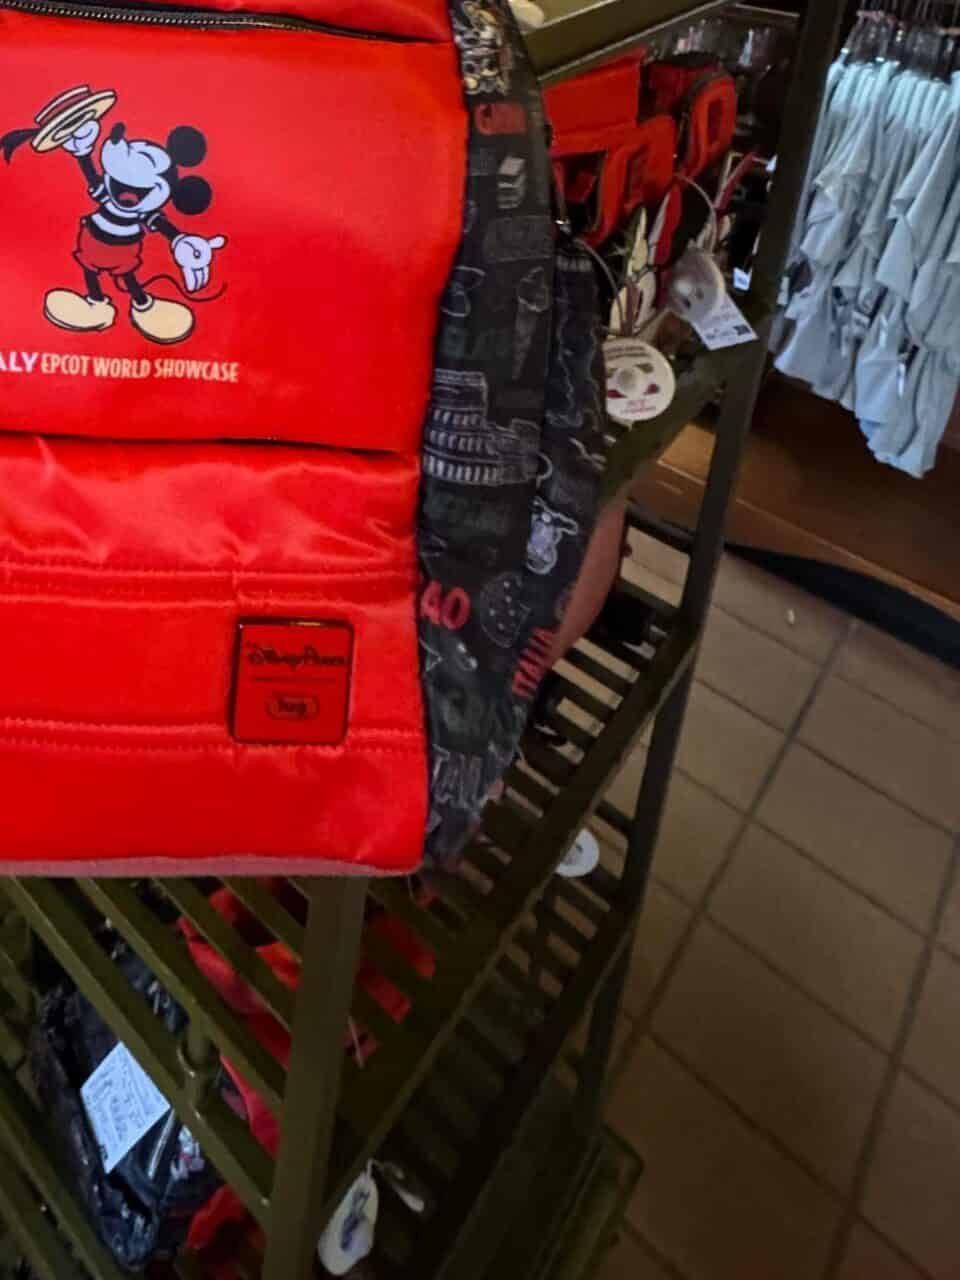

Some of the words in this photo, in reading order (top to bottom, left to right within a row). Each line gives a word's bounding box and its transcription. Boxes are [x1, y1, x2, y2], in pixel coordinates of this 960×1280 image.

[40, 353, 91, 377] EPCOT
[93, 357, 151, 379] WORLD
[153, 358, 240, 384] SHOWCASE
